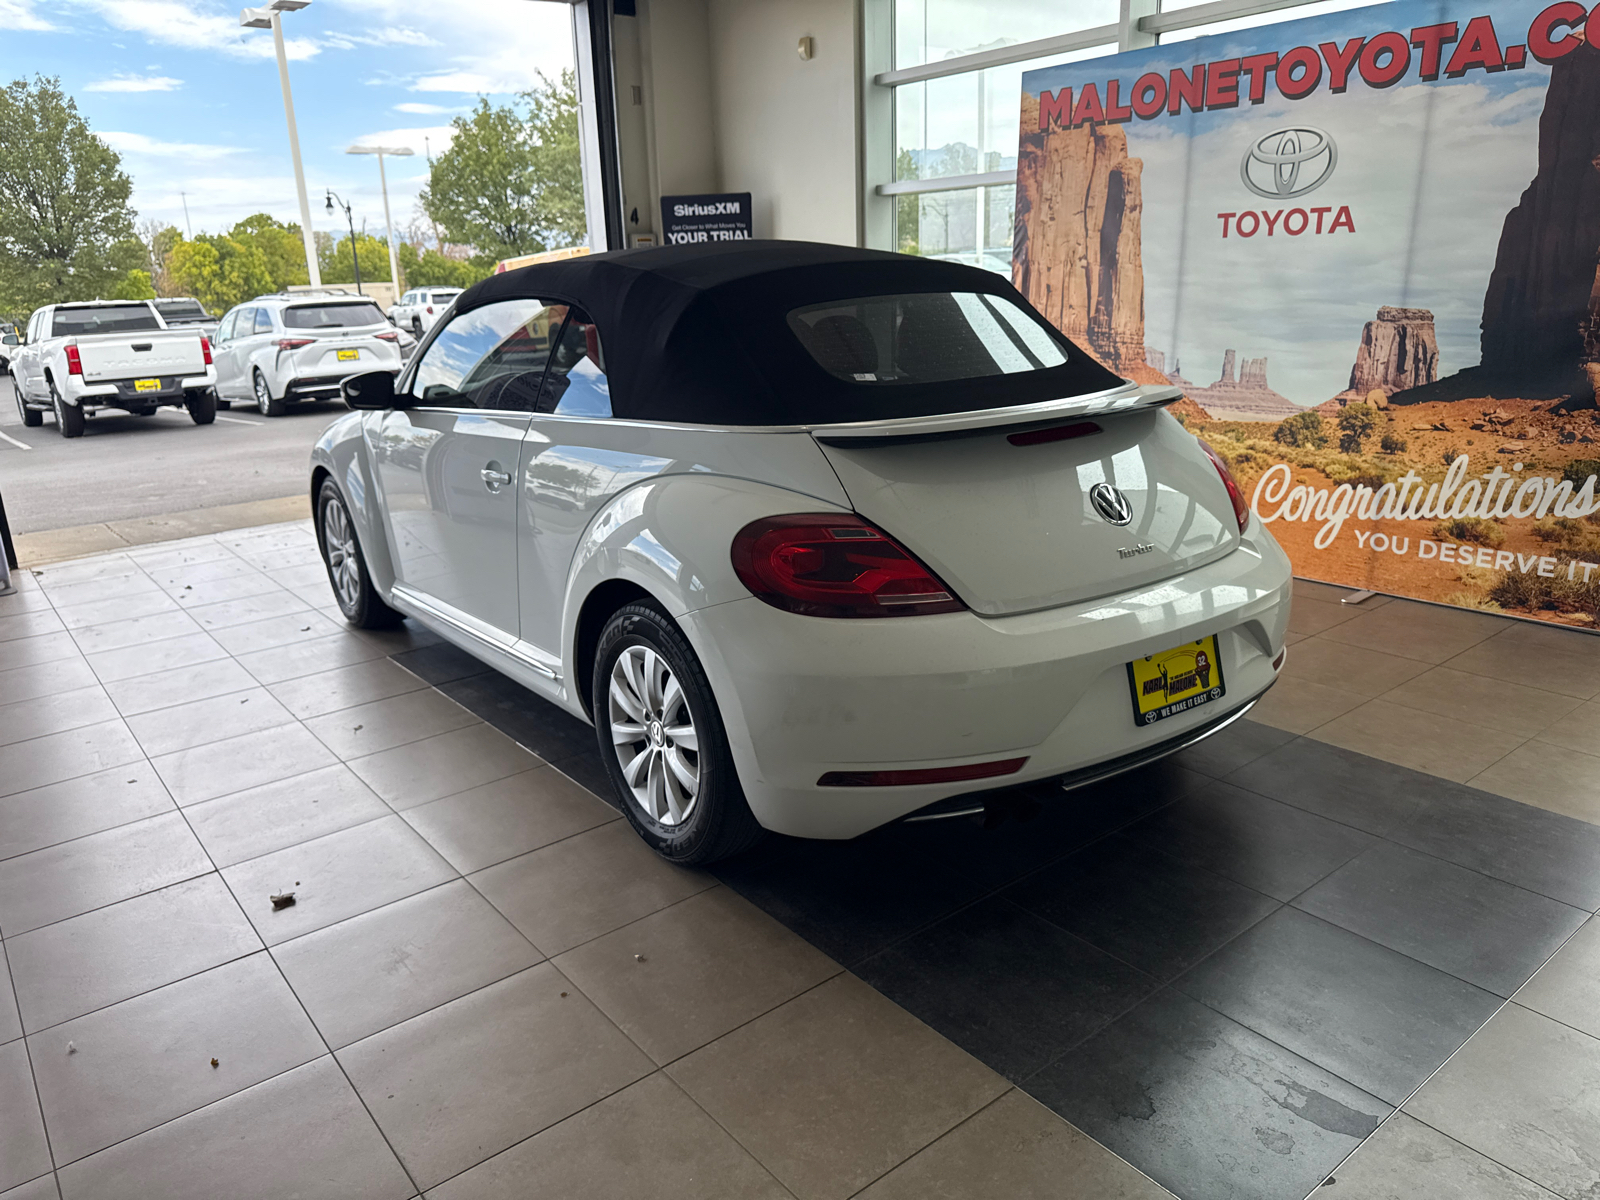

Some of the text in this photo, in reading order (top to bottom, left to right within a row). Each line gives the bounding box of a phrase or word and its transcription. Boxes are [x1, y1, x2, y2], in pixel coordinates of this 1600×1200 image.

[1038, 0, 1600, 133] MALONETOYOTA.C
[630, 207, 639, 226] 4
[674, 203, 740, 216] SiriusXM
[1217, 205, 1356, 239] TOYOTA
[668, 230, 752, 245] YOUR TRIAL
[1250, 453, 1600, 550] Congratulations
[1117, 543, 1154, 559] Turbo
[1354, 530, 1409, 555] YOU
[1417, 538, 1558, 578] DESERVE
[1198, 656, 1206, 666] 32
[1143, 677, 1164, 696] KARL
[1169, 674, 1198, 696] MALONE
[1161, 694, 1207, 717] WE MAKE IT EASY
